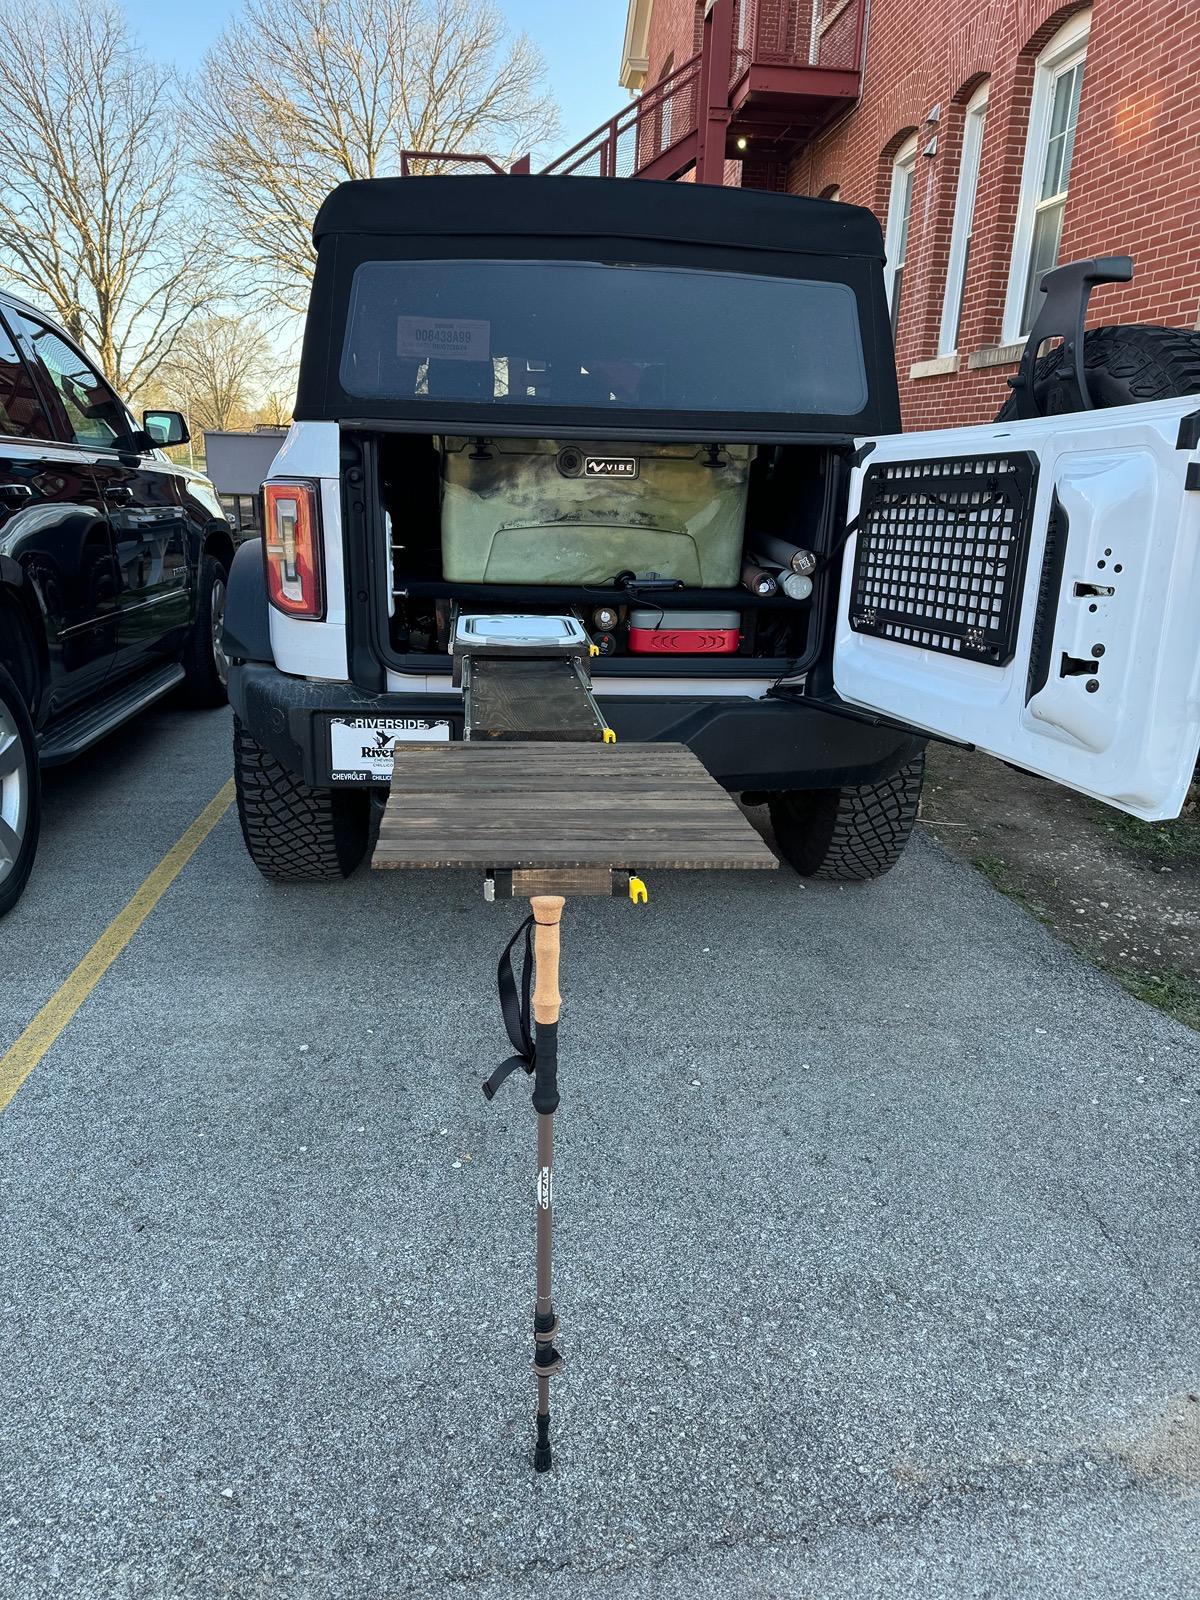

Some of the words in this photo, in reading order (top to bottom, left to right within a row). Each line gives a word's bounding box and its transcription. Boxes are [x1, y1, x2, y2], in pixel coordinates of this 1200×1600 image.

[355, 718, 425, 730] RIVERSIDE
[361, 746, 395, 758] River
[331, 772, 367, 781] CHEVROLET
